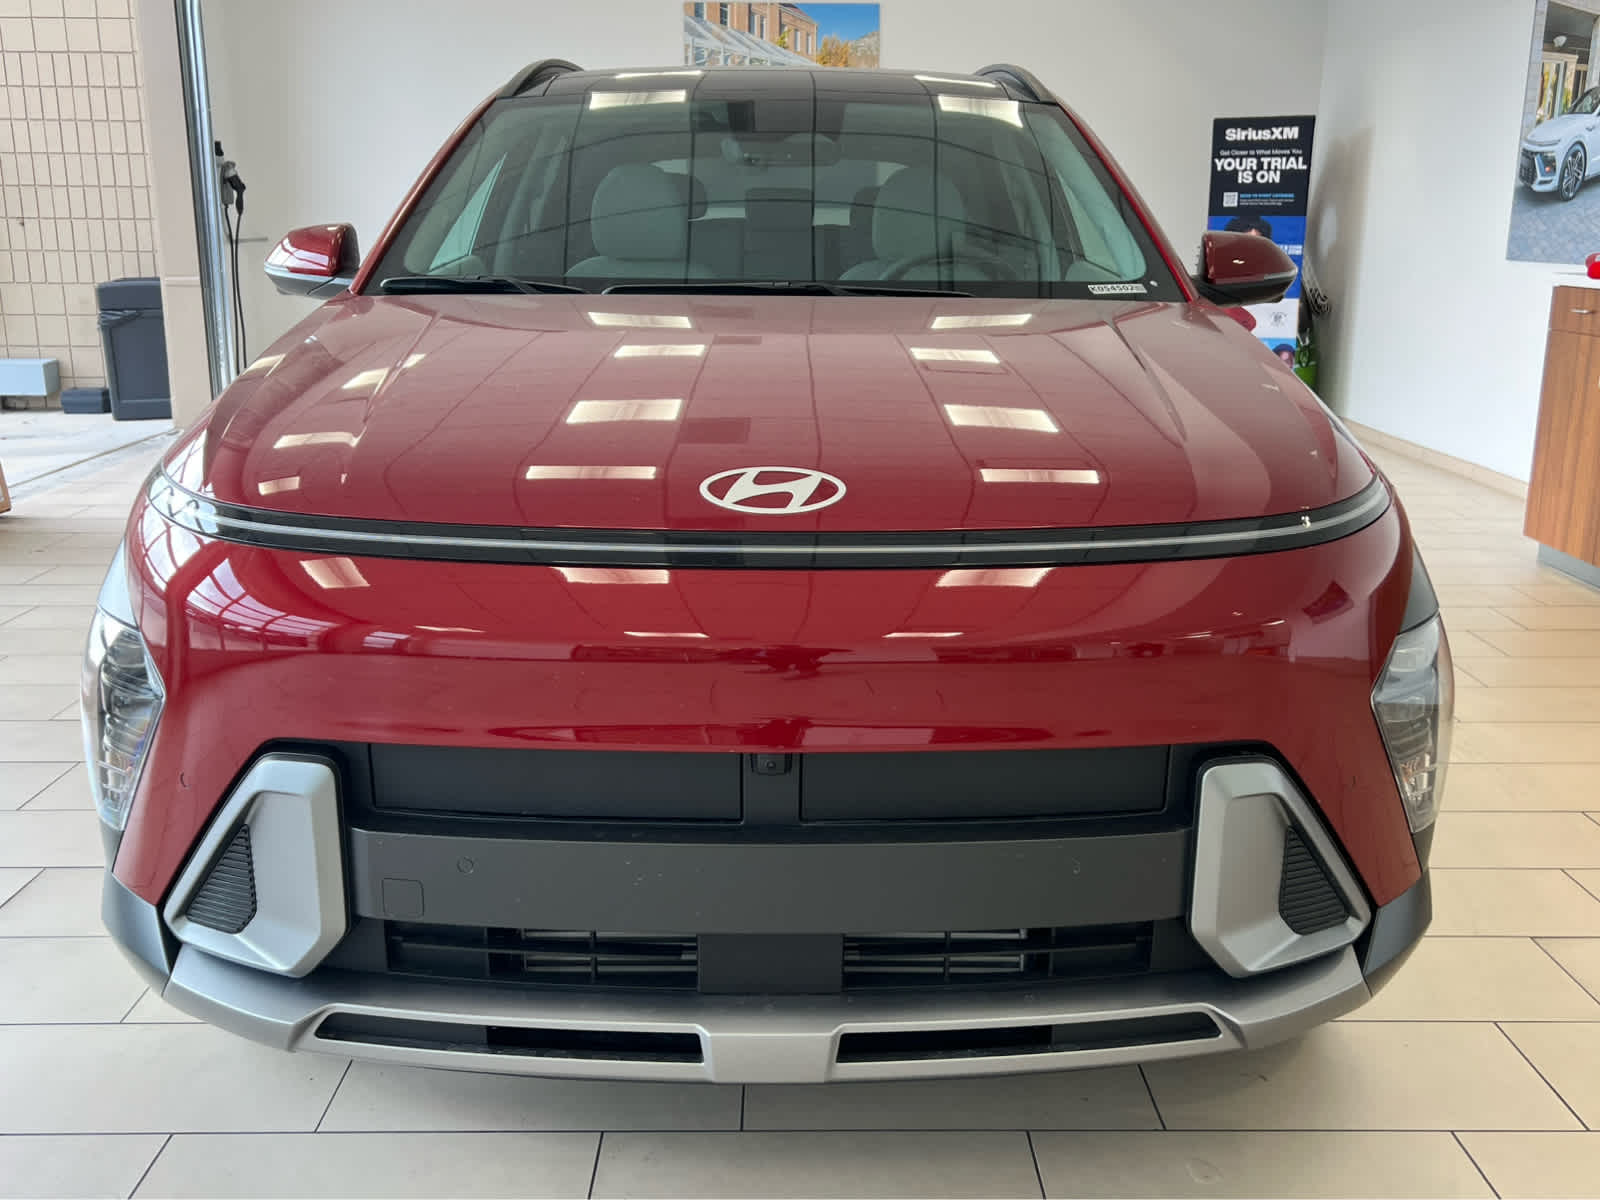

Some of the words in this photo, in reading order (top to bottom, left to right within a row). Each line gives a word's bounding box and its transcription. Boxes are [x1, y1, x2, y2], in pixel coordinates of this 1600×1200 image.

[1225, 126, 1299, 141] SiriusXM
[1214, 157, 1258, 171] YOUR
[1260, 156, 1307, 170] TRIAL
[1237, 170, 1253, 184] IS
[1256, 170, 1281, 184] ON
